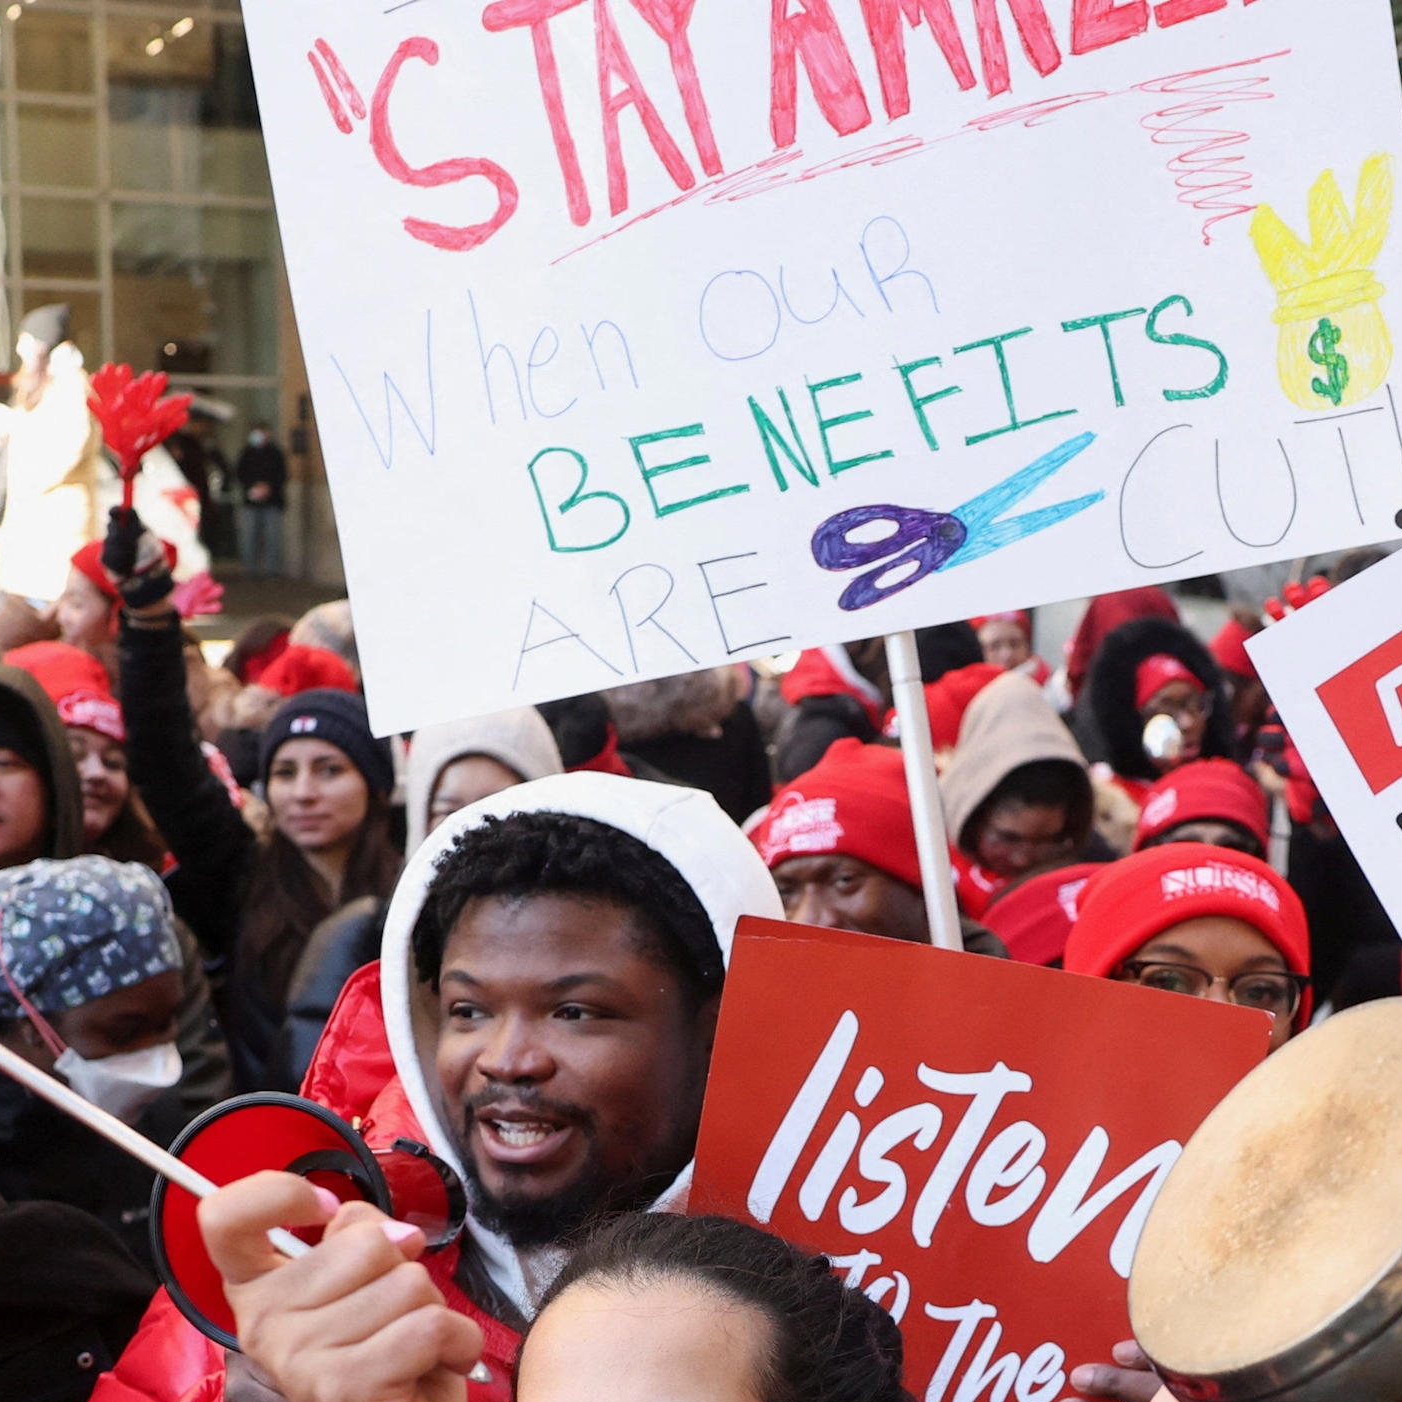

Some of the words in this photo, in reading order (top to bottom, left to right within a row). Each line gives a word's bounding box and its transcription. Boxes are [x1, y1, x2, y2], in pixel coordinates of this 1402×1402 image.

[332, 286, 638, 470] When
[528, 294, 1229, 553] BENEFITS
[512, 551, 792, 690] ARE
